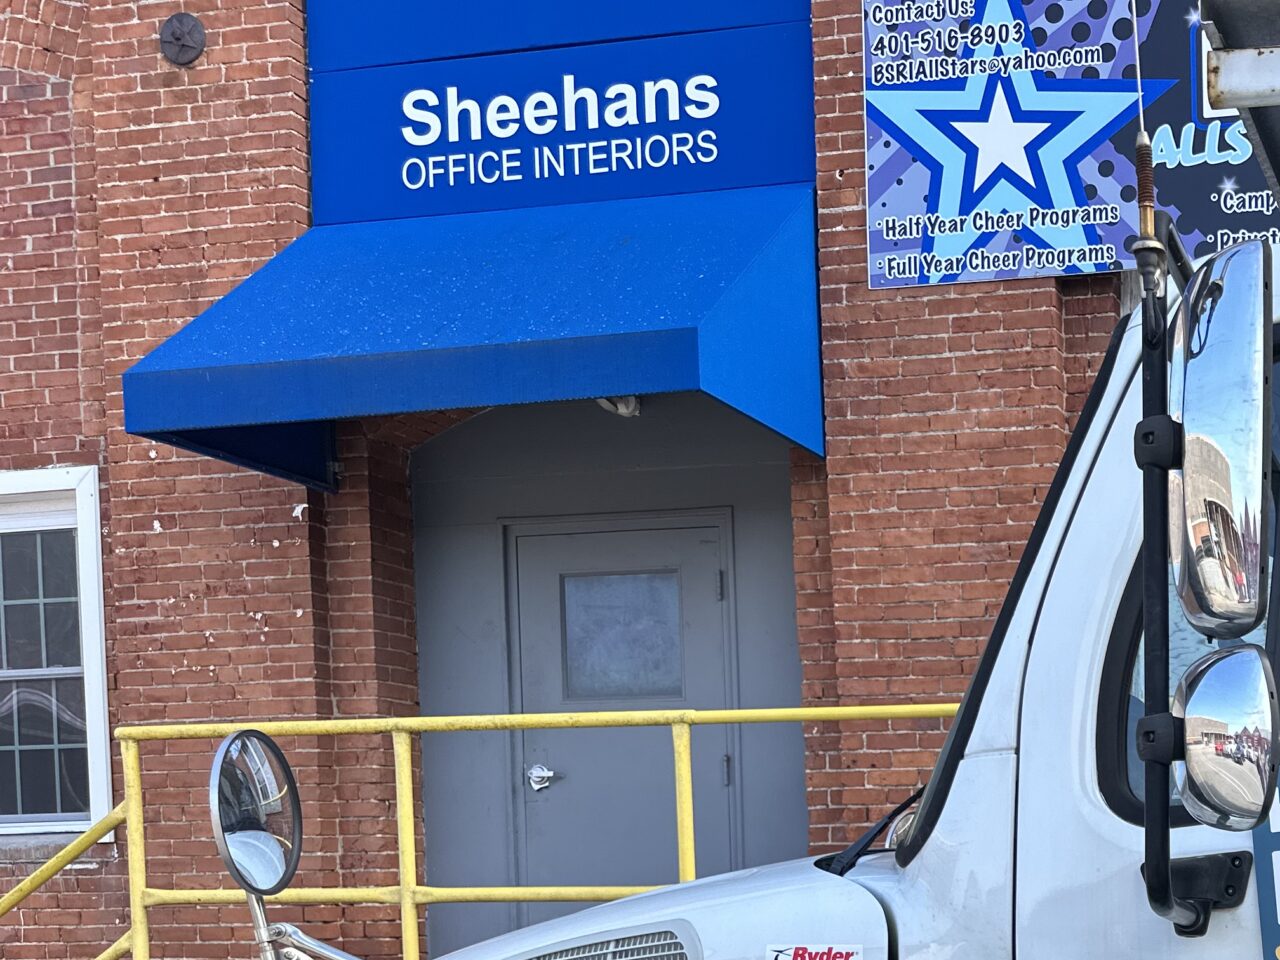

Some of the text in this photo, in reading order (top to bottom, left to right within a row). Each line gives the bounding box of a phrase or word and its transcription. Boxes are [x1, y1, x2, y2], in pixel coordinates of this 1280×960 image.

[872, 0, 974, 23] Contact Us:
[872, 21, 1025, 57] 401-516-8903
[872, 46, 1102, 84] BSRIAllStars@yahoo.com
[401, 74, 720, 146] Sheehans
[402, 130, 718, 190] OFFICE INTERIORS
[1221, 189, 1278, 215] Camp
[884, 204, 1119, 238] Half Year Cheer Programs
[886, 245, 1115, 277] Full Year Cheer Programs
